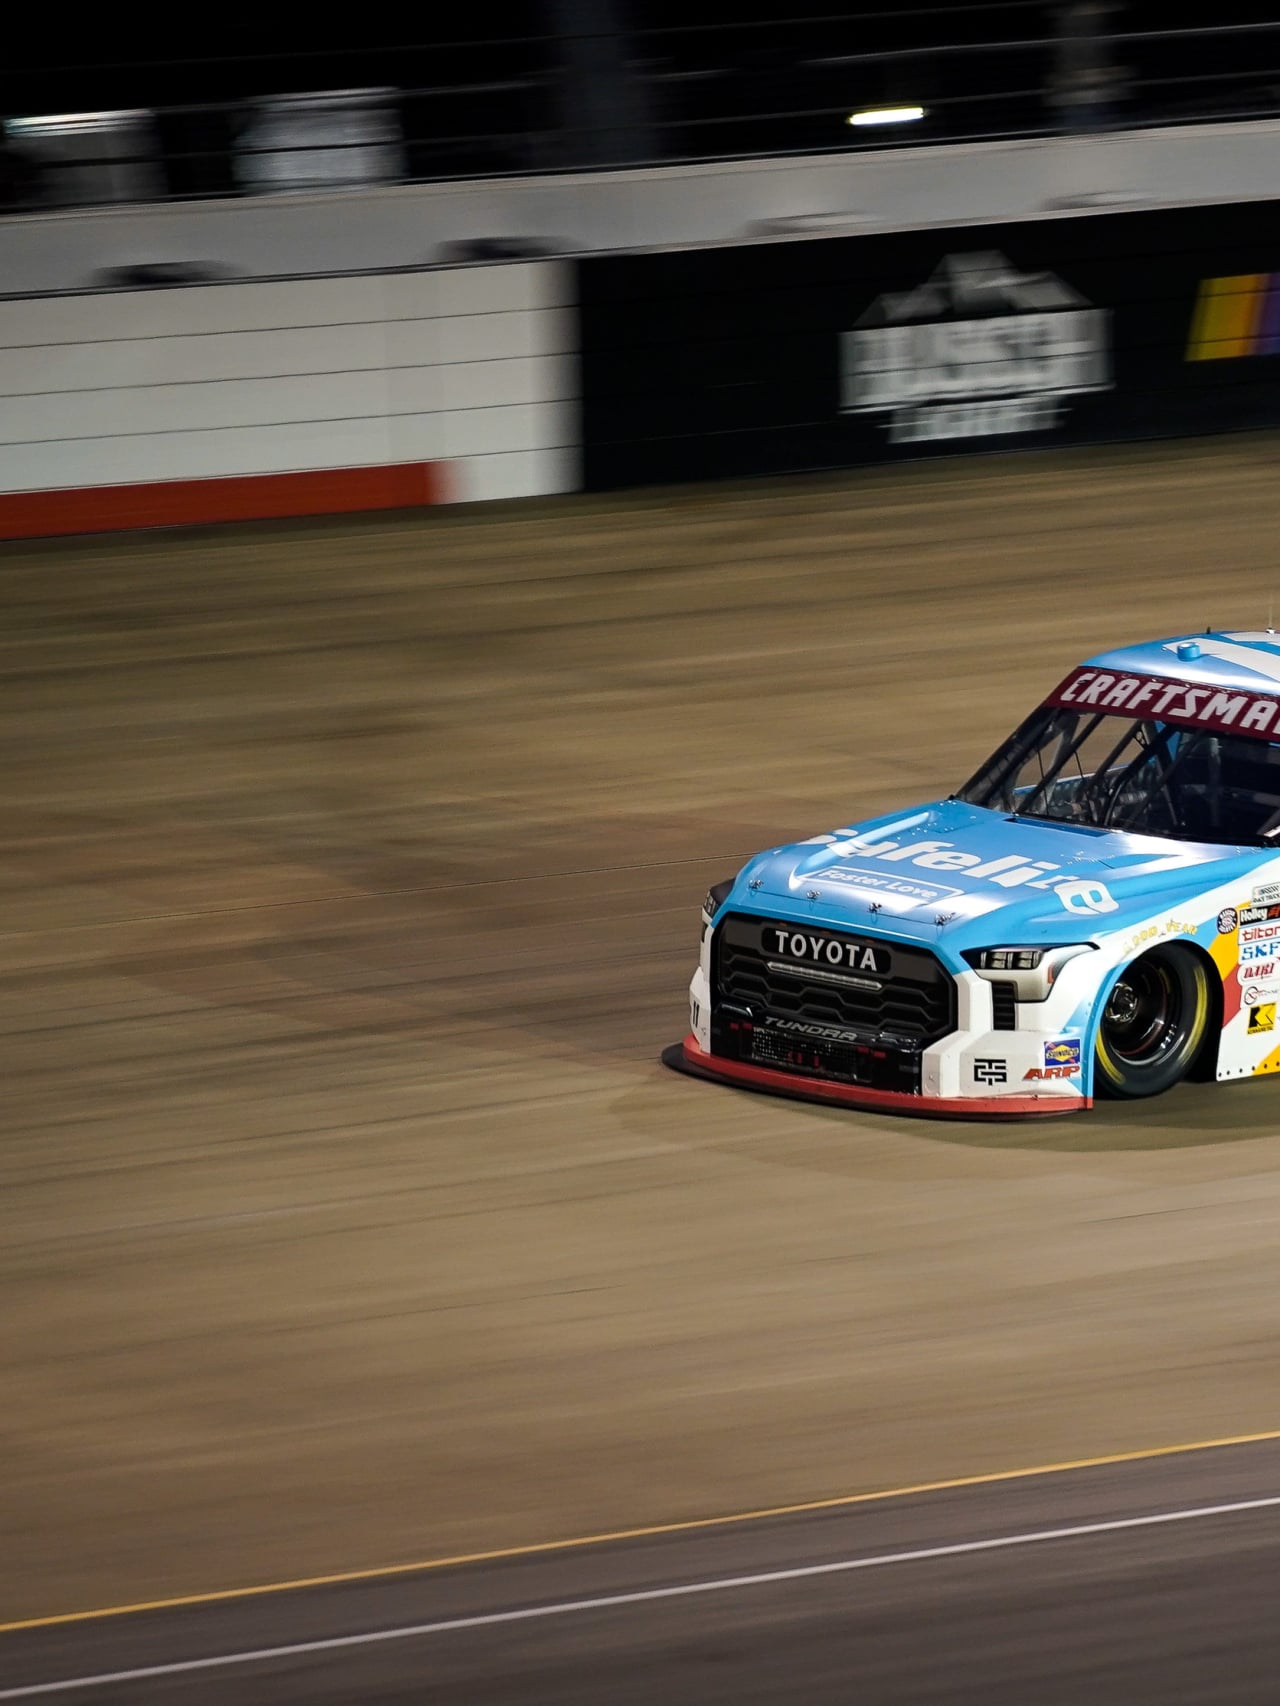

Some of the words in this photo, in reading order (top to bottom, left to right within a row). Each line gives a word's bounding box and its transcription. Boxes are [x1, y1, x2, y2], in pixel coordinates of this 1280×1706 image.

[819, 868, 889, 888] Foster
[888, 879, 939, 899] Love
[1240, 907, 1268, 922] Holley
[775, 930, 878, 972] TOYOTA
[765, 1016, 858, 1042] TUNDRA
[1021, 1065, 1081, 1082] ARP
